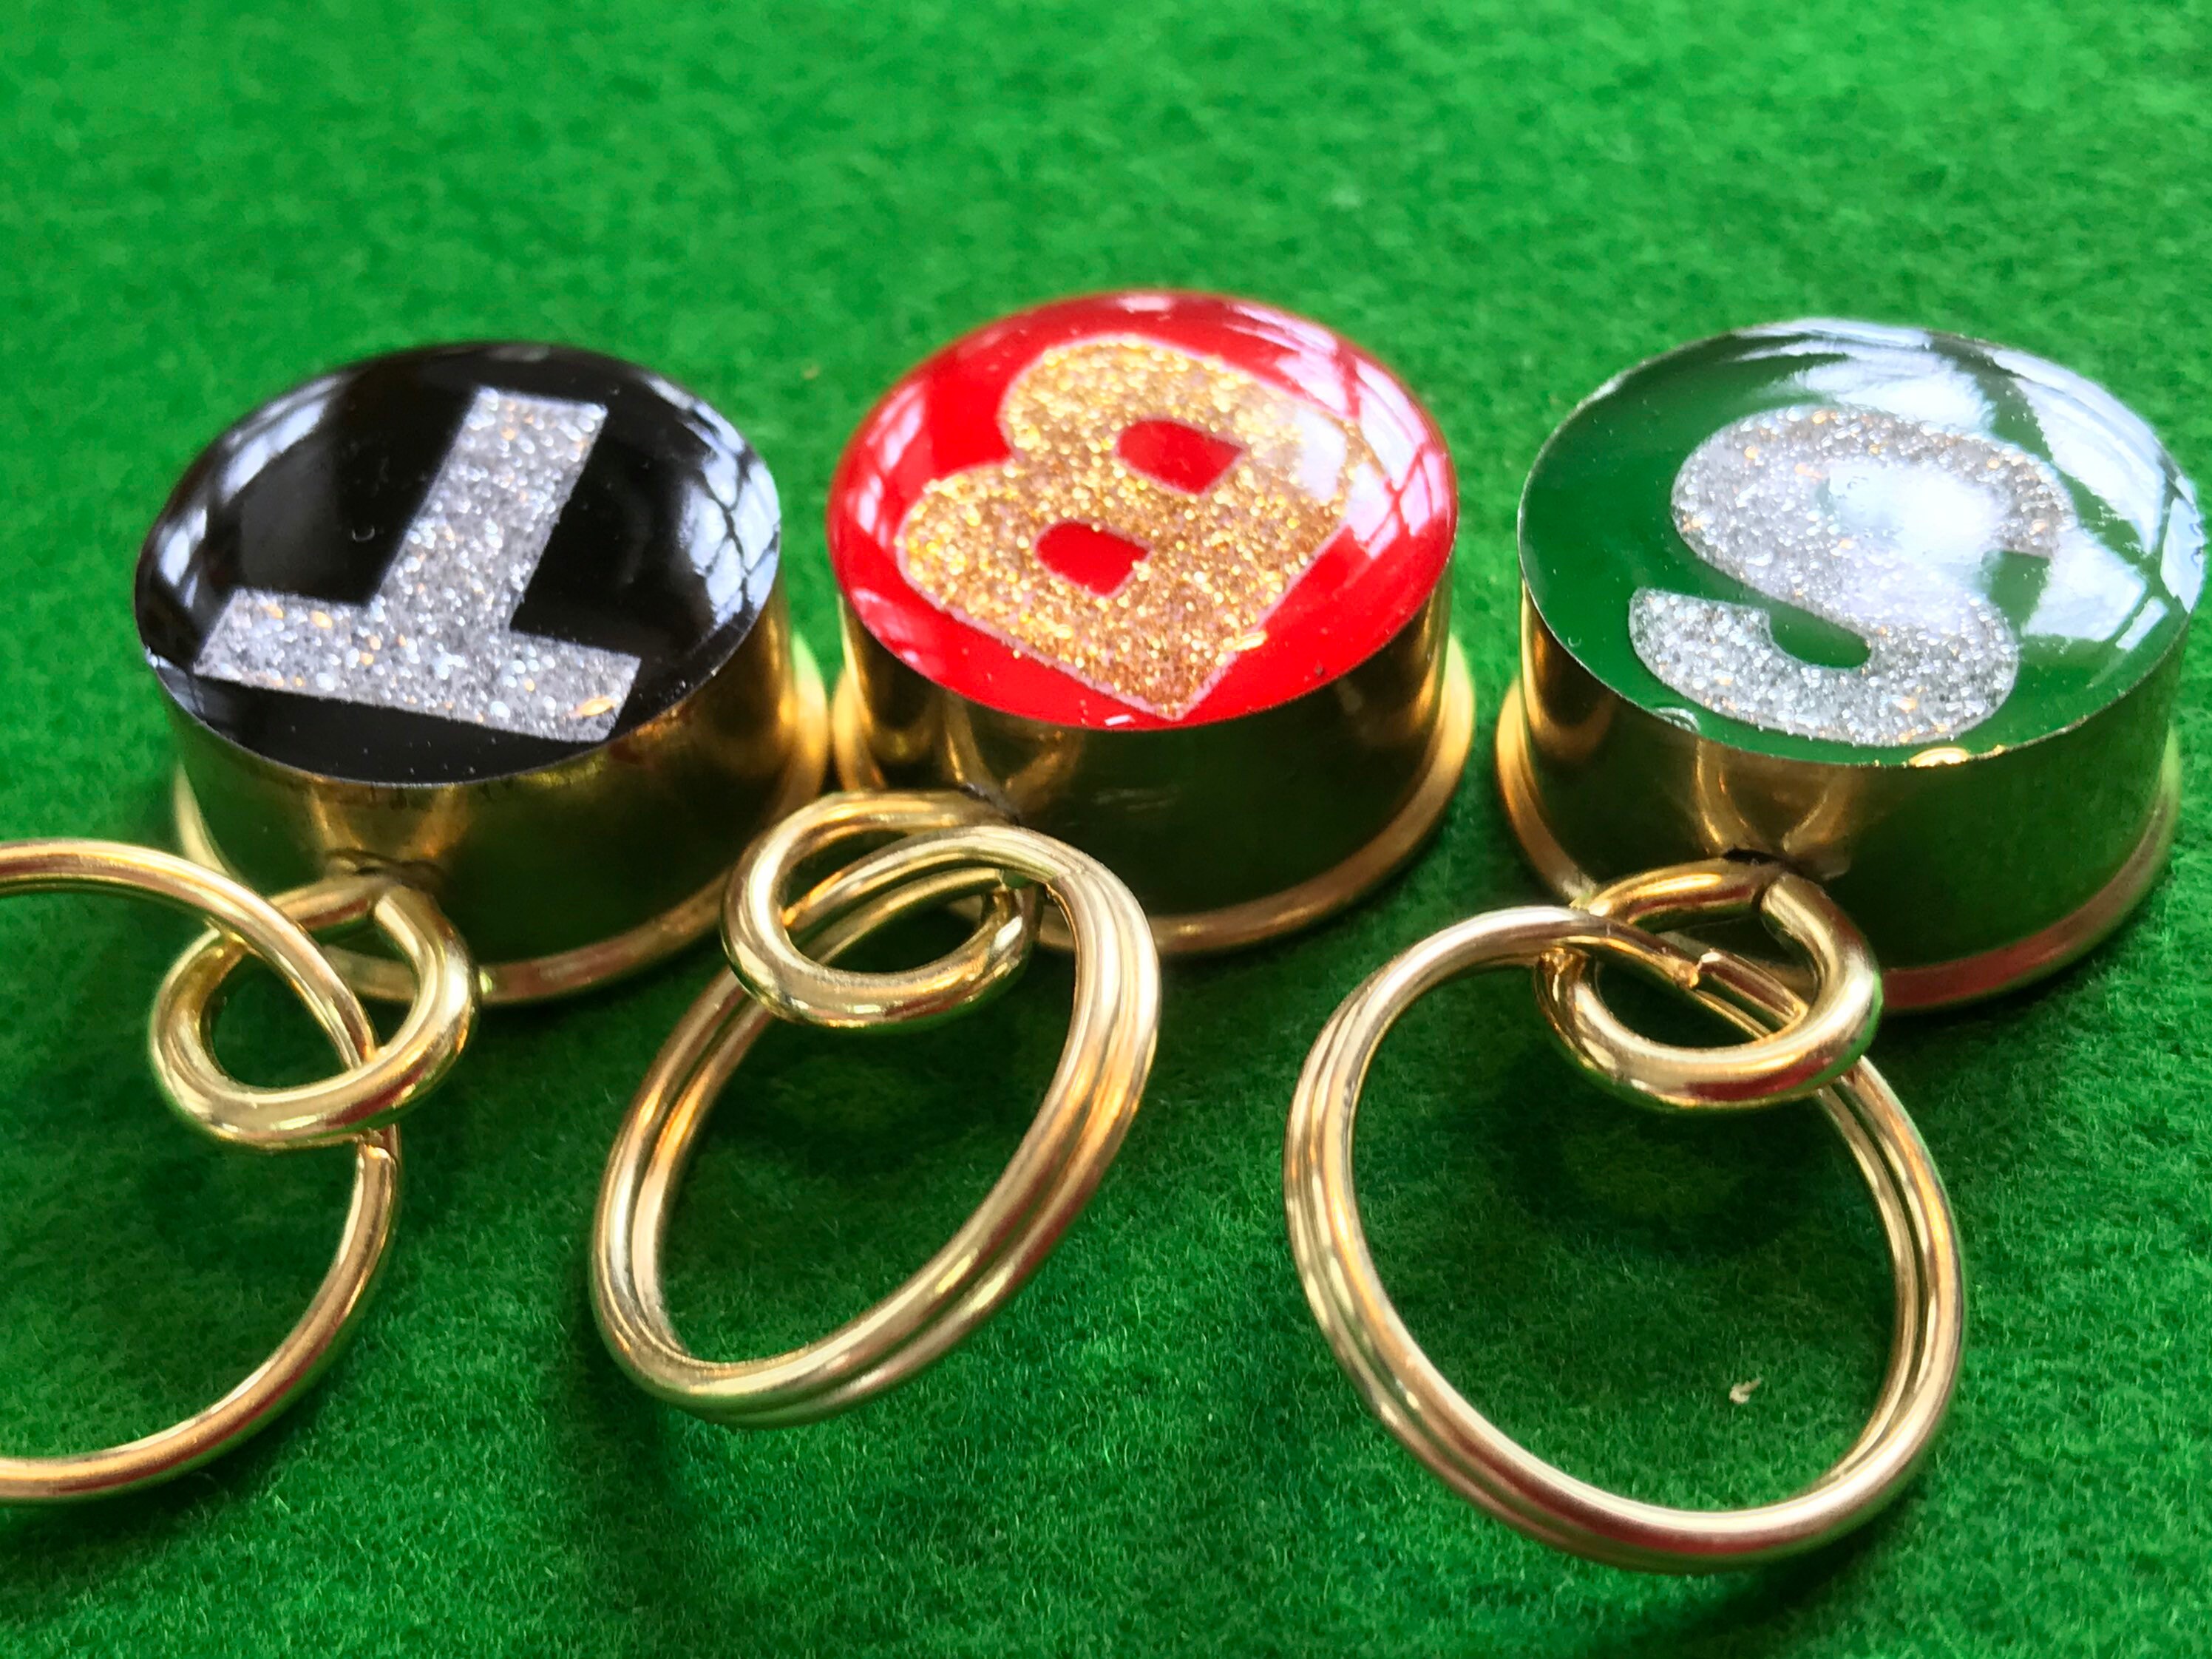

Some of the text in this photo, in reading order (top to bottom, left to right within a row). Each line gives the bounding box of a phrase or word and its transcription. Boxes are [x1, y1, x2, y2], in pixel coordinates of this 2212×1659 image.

[194, 386, 642, 743] T
[896, 333, 1385, 722] B
[1628, 404, 2076, 747] S
